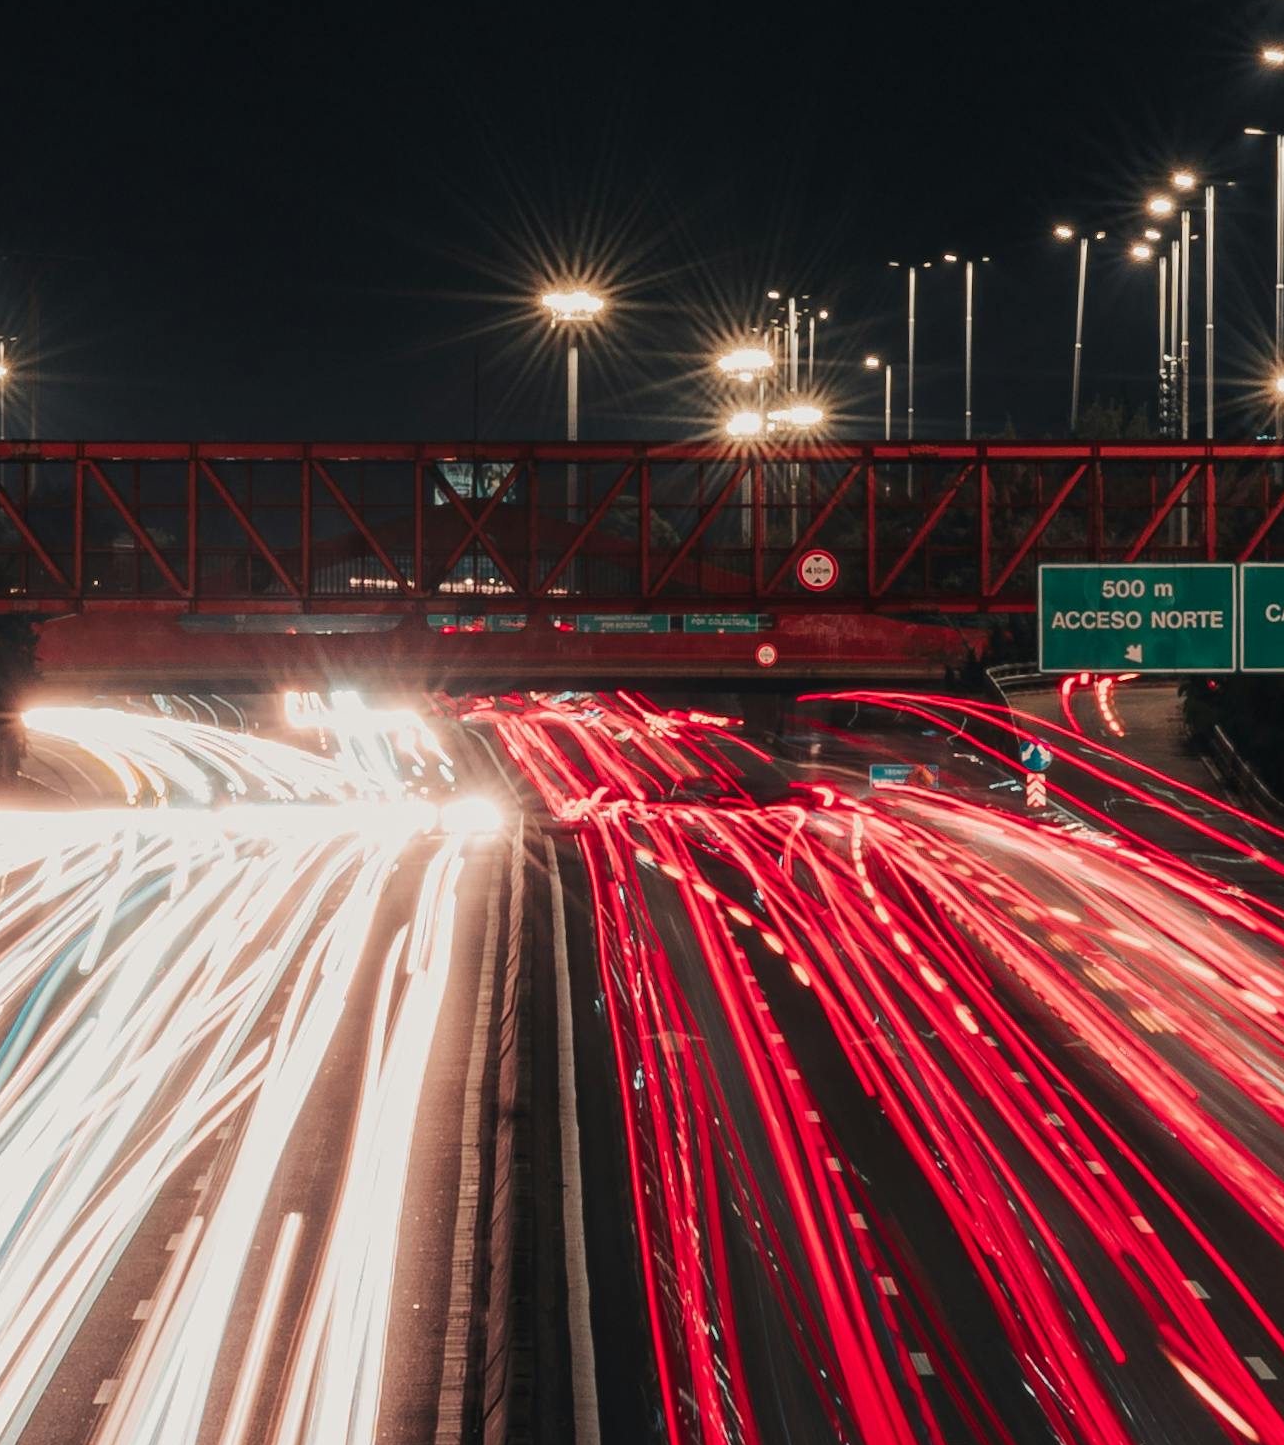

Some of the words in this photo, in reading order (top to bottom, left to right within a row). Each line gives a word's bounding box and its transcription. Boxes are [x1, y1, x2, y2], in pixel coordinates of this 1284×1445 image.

[1102, 579, 1146, 598] 500
[1154, 583, 1173, 597] m
[1051, 611, 1142, 629] ACCESO
[1151, 611, 1224, 629] NORTE
